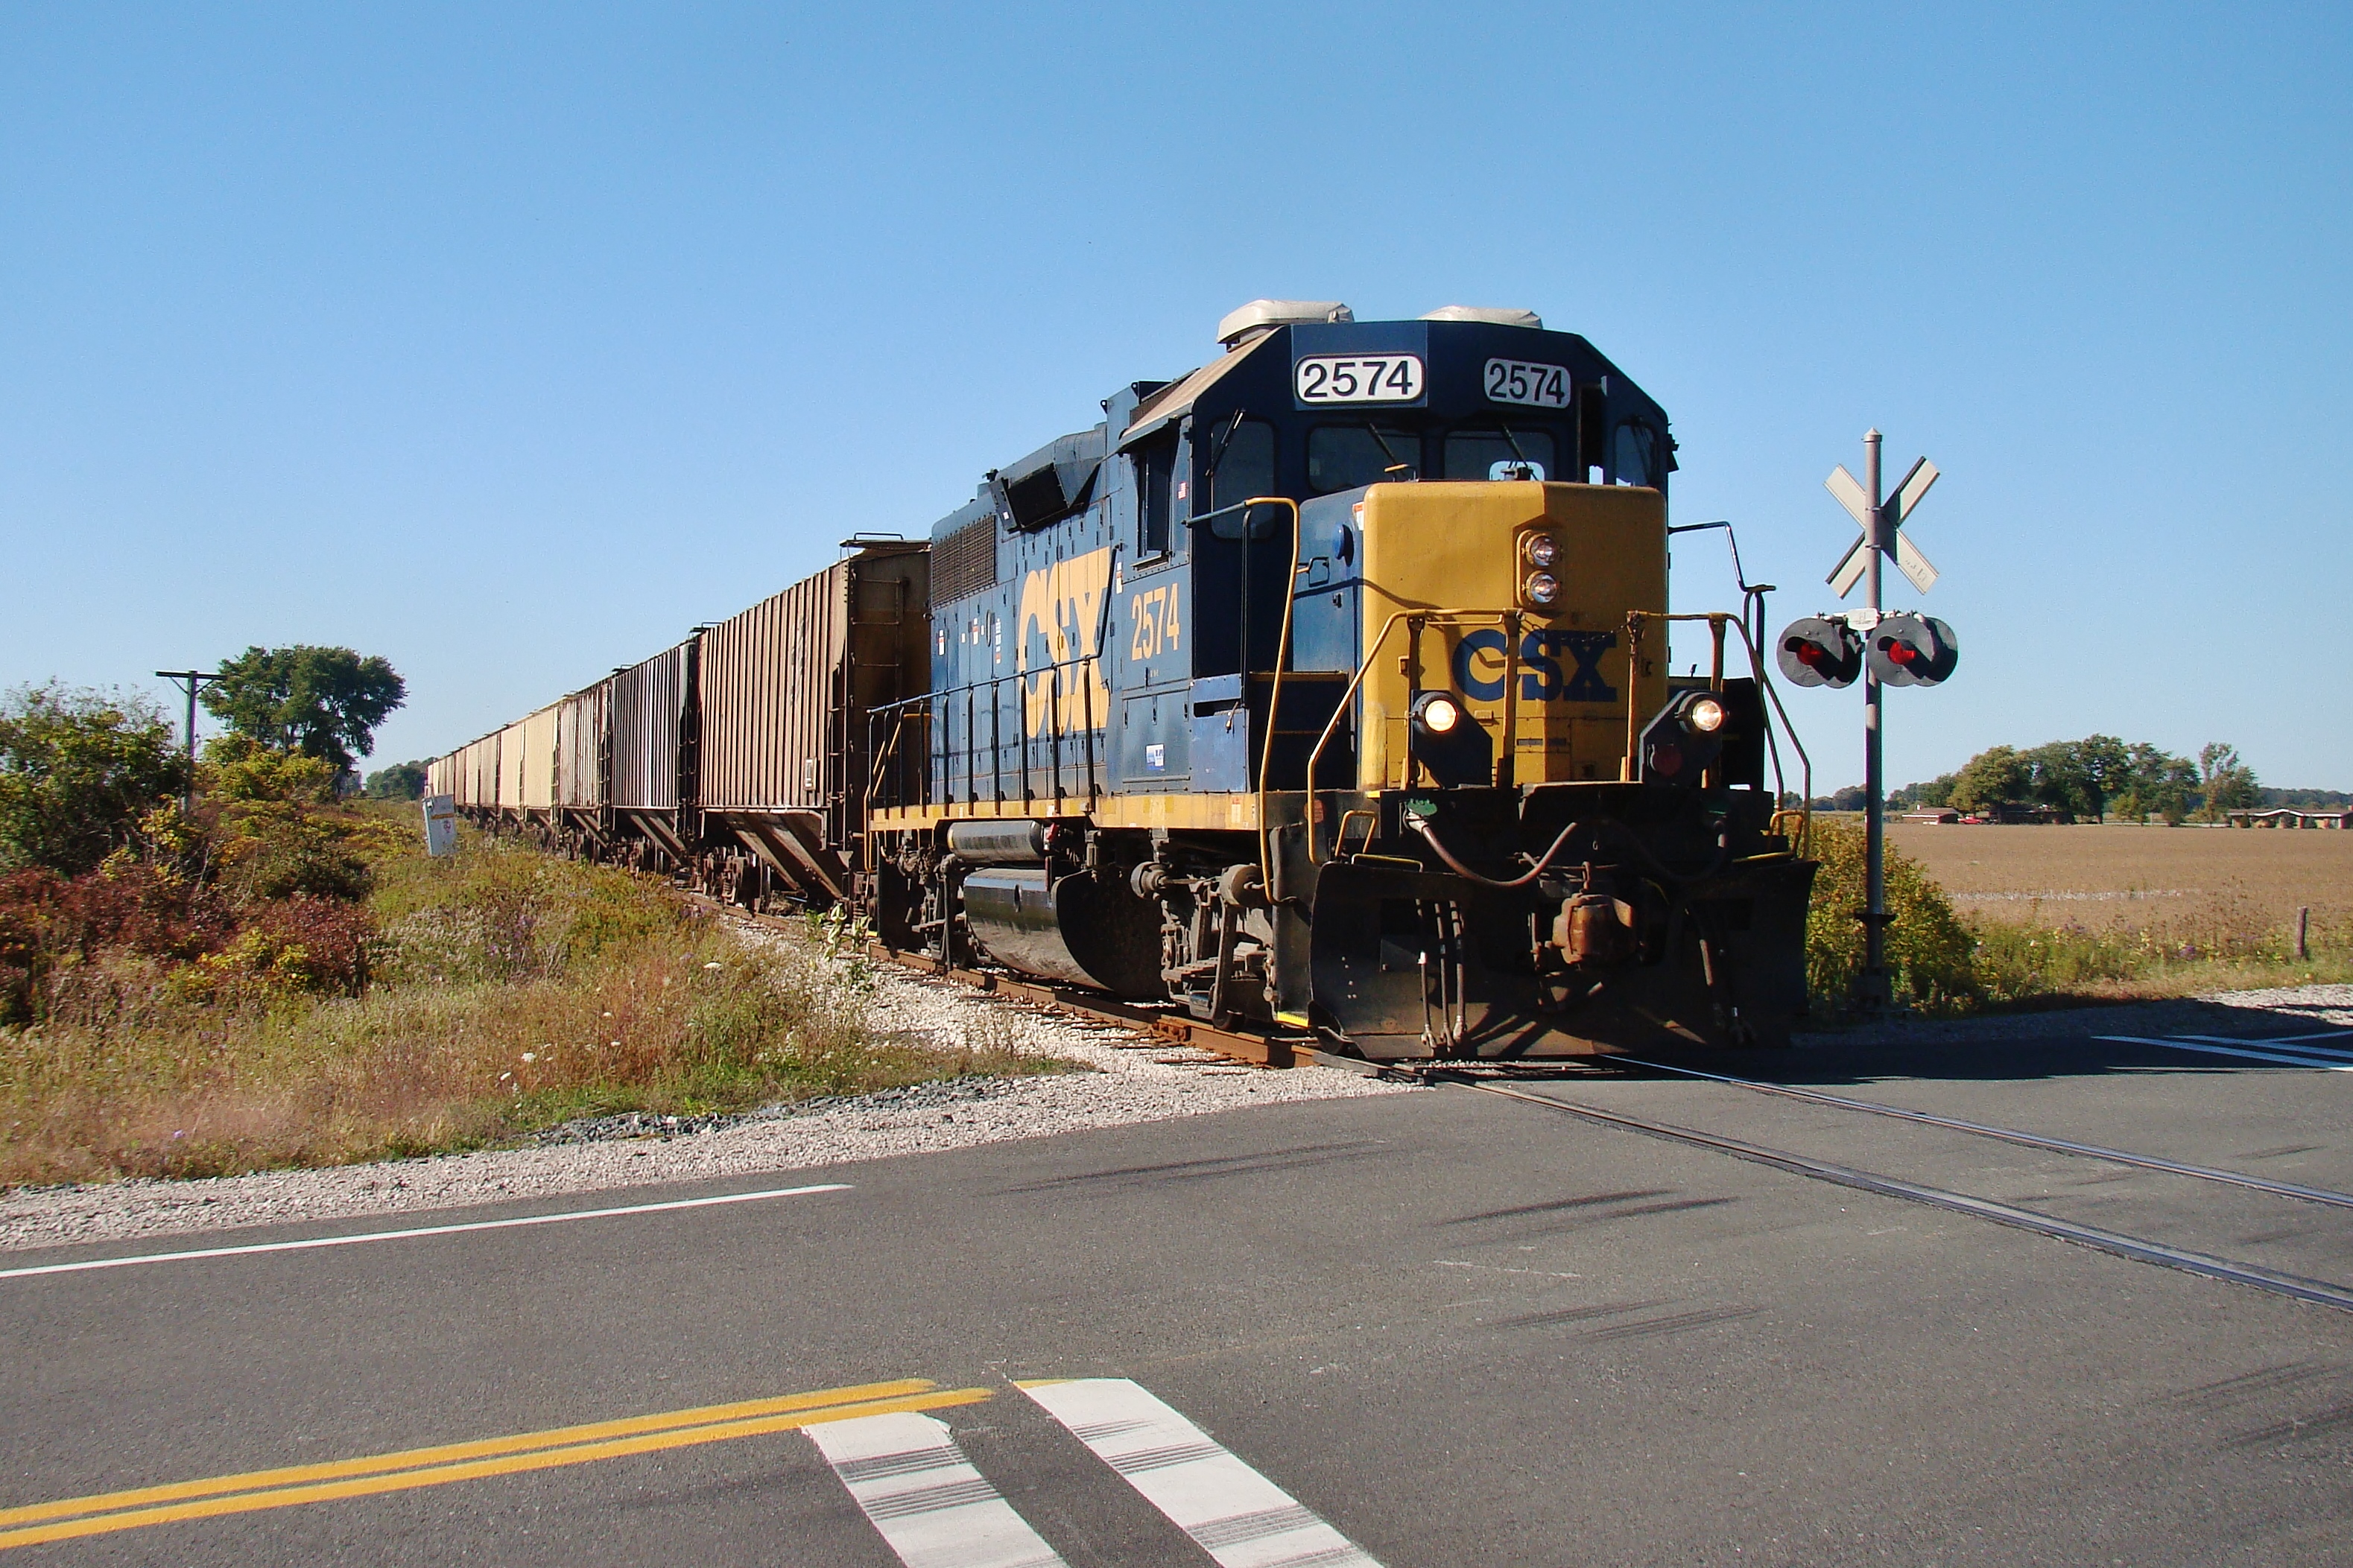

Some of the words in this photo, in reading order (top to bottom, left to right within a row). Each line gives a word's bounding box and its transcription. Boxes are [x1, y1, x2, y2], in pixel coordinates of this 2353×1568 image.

[1303, 361, 1413, 398] 2574
[1489, 363, 1564, 404] 2574
[1018, 547, 1112, 737] CSX
[1132, 583, 1179, 661] 2574
[1453, 629, 1617, 702] CSX
